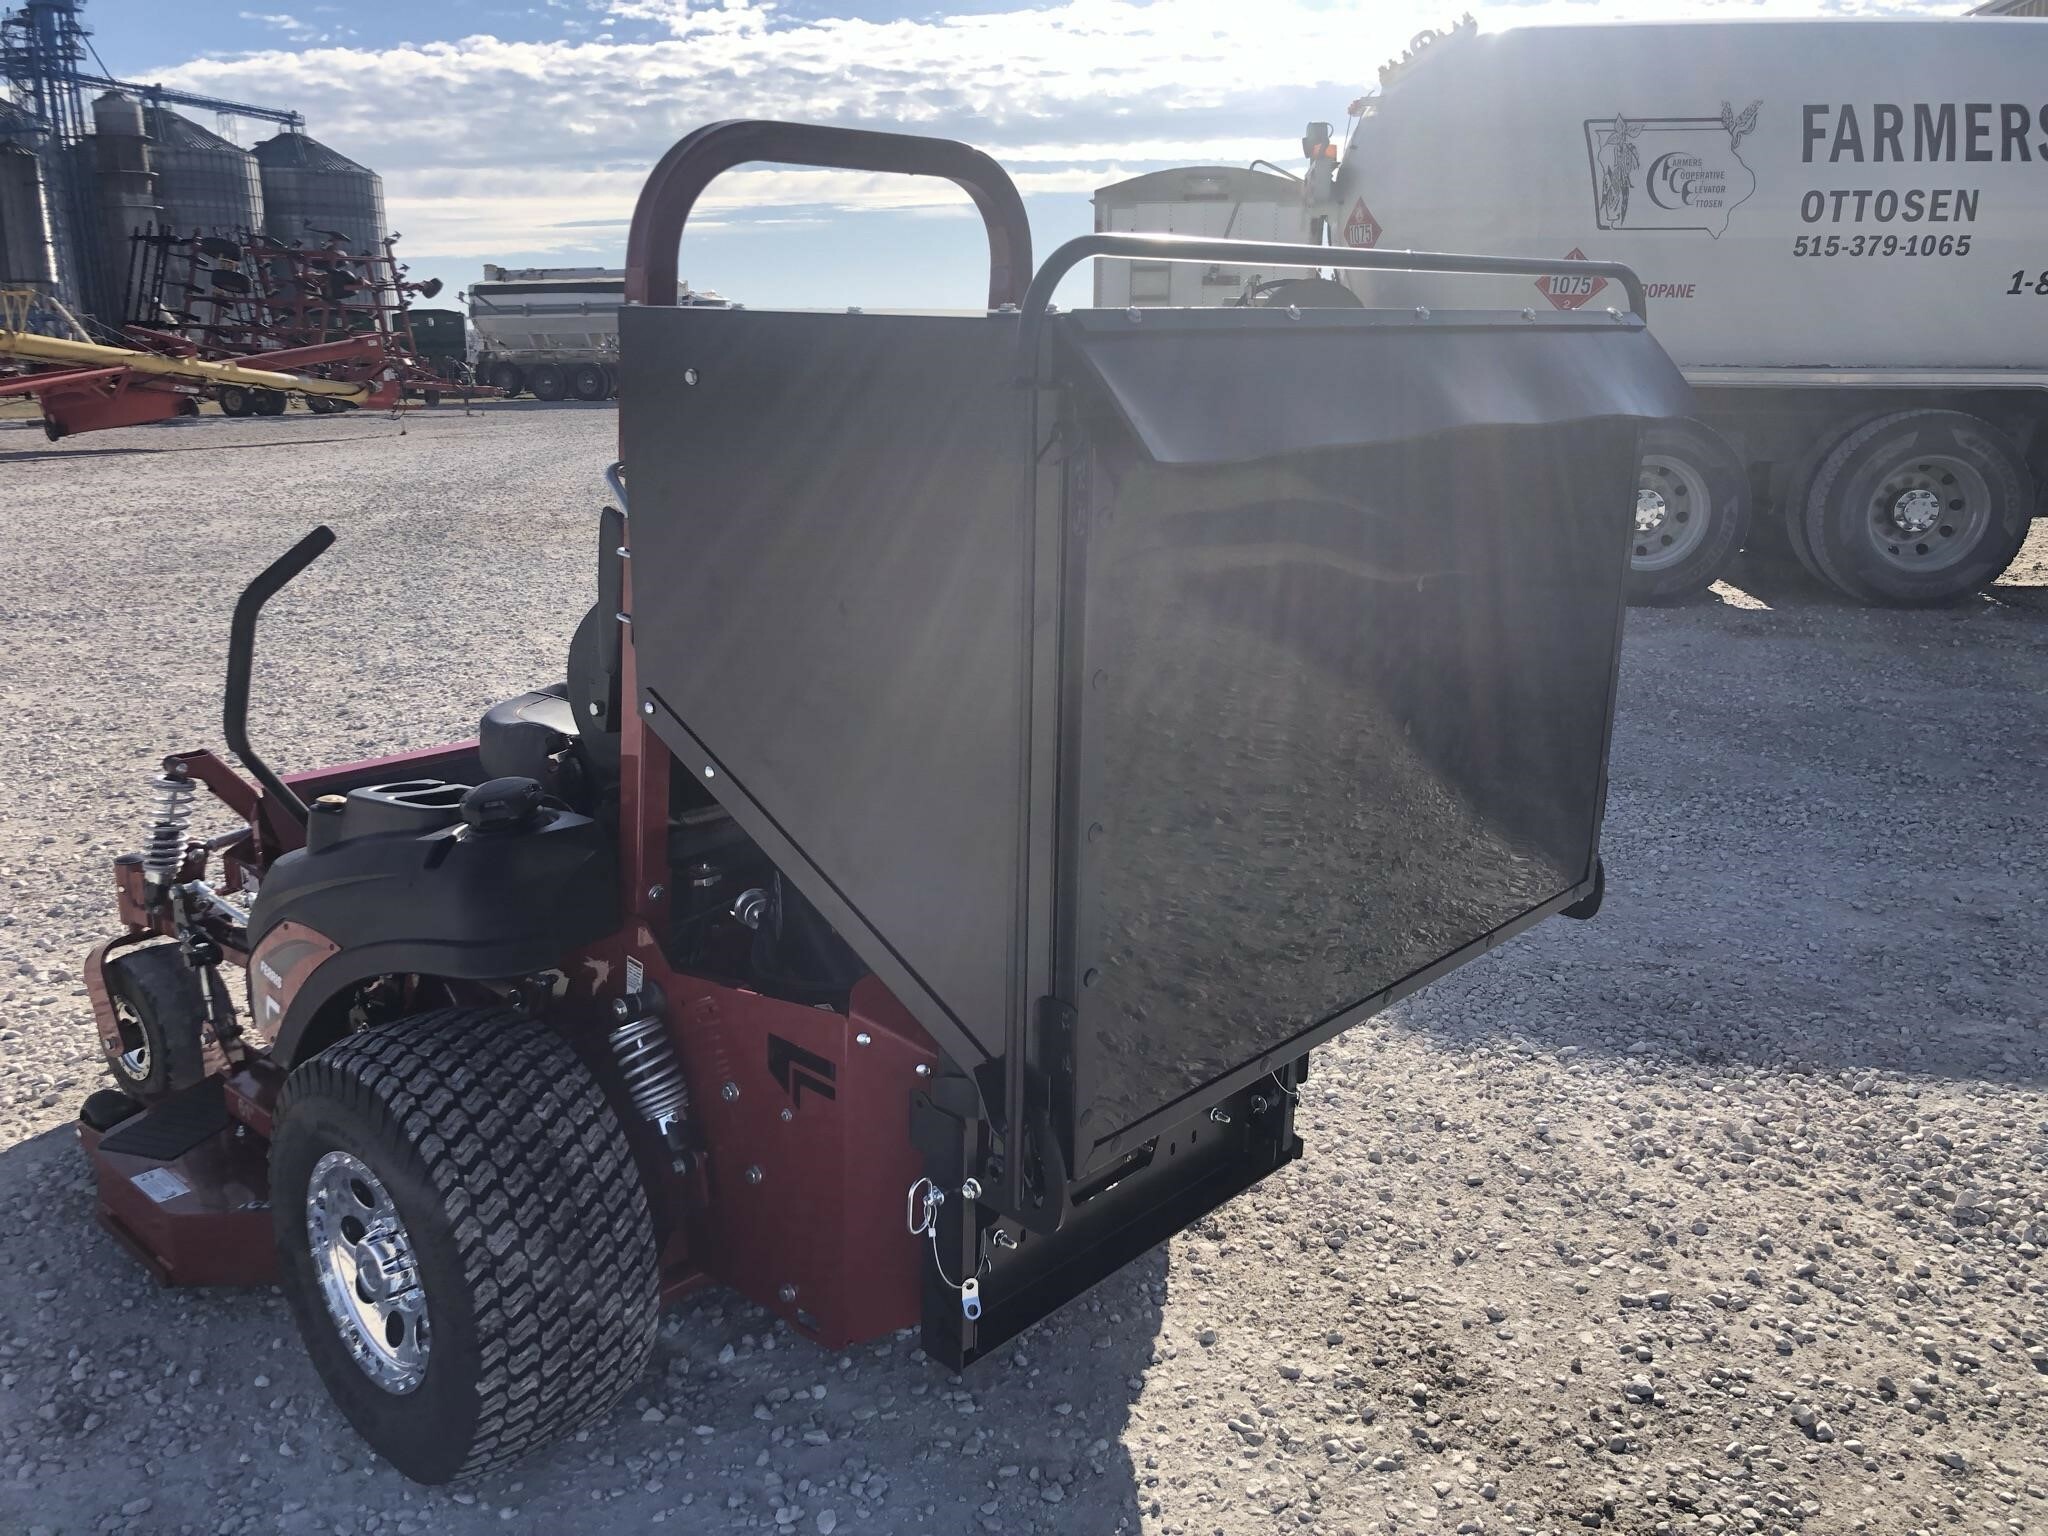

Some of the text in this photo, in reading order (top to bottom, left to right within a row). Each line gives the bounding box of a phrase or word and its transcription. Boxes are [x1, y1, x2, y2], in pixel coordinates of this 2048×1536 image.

[1800, 189, 1980, 223] OTTOSEN
[1350, 224, 1373, 244] 1075
[1793, 234, 1972, 257] 515-379-1065
[1552, 276, 1592, 294] 1075
[1639, 283, 1697, 298] ROPANE
